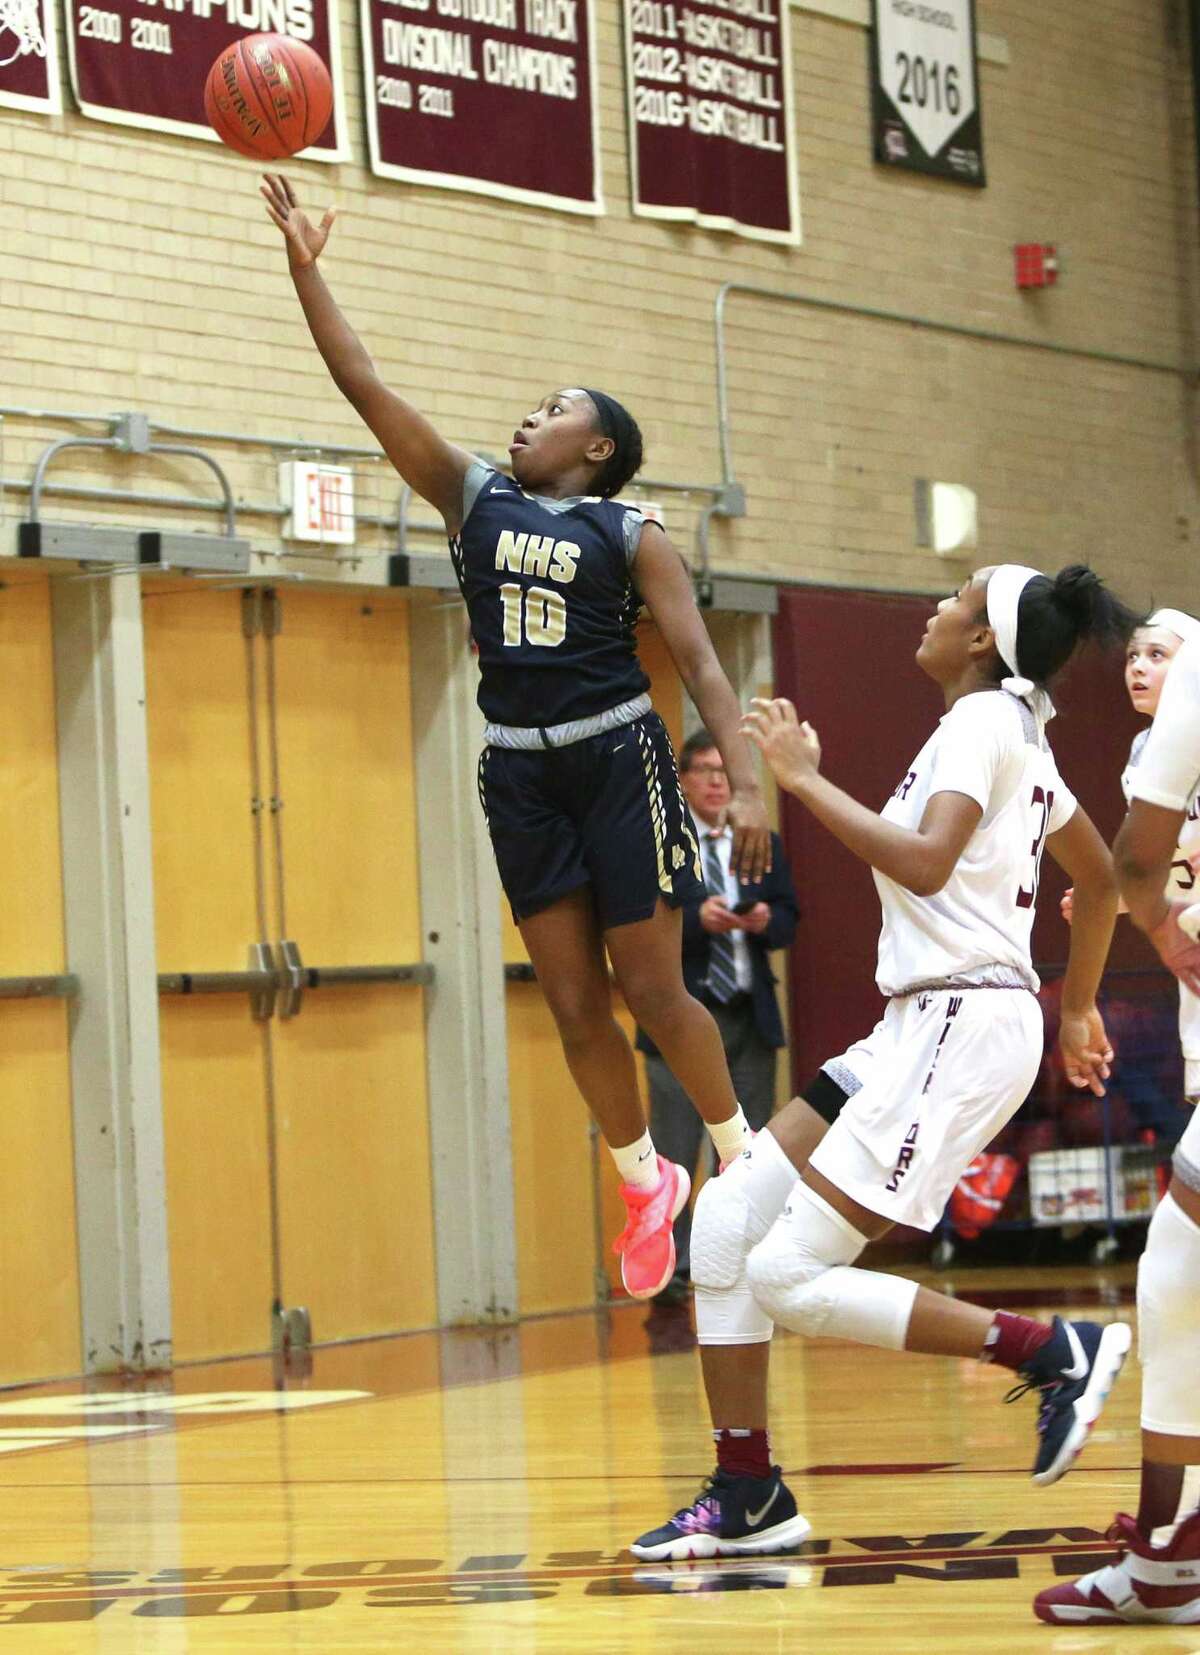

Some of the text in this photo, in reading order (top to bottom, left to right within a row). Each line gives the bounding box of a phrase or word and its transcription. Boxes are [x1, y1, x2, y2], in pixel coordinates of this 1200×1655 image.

[896, 51, 961, 116] 2016
[495, 529, 582, 584] NHS
[499, 582, 567, 647] 10
